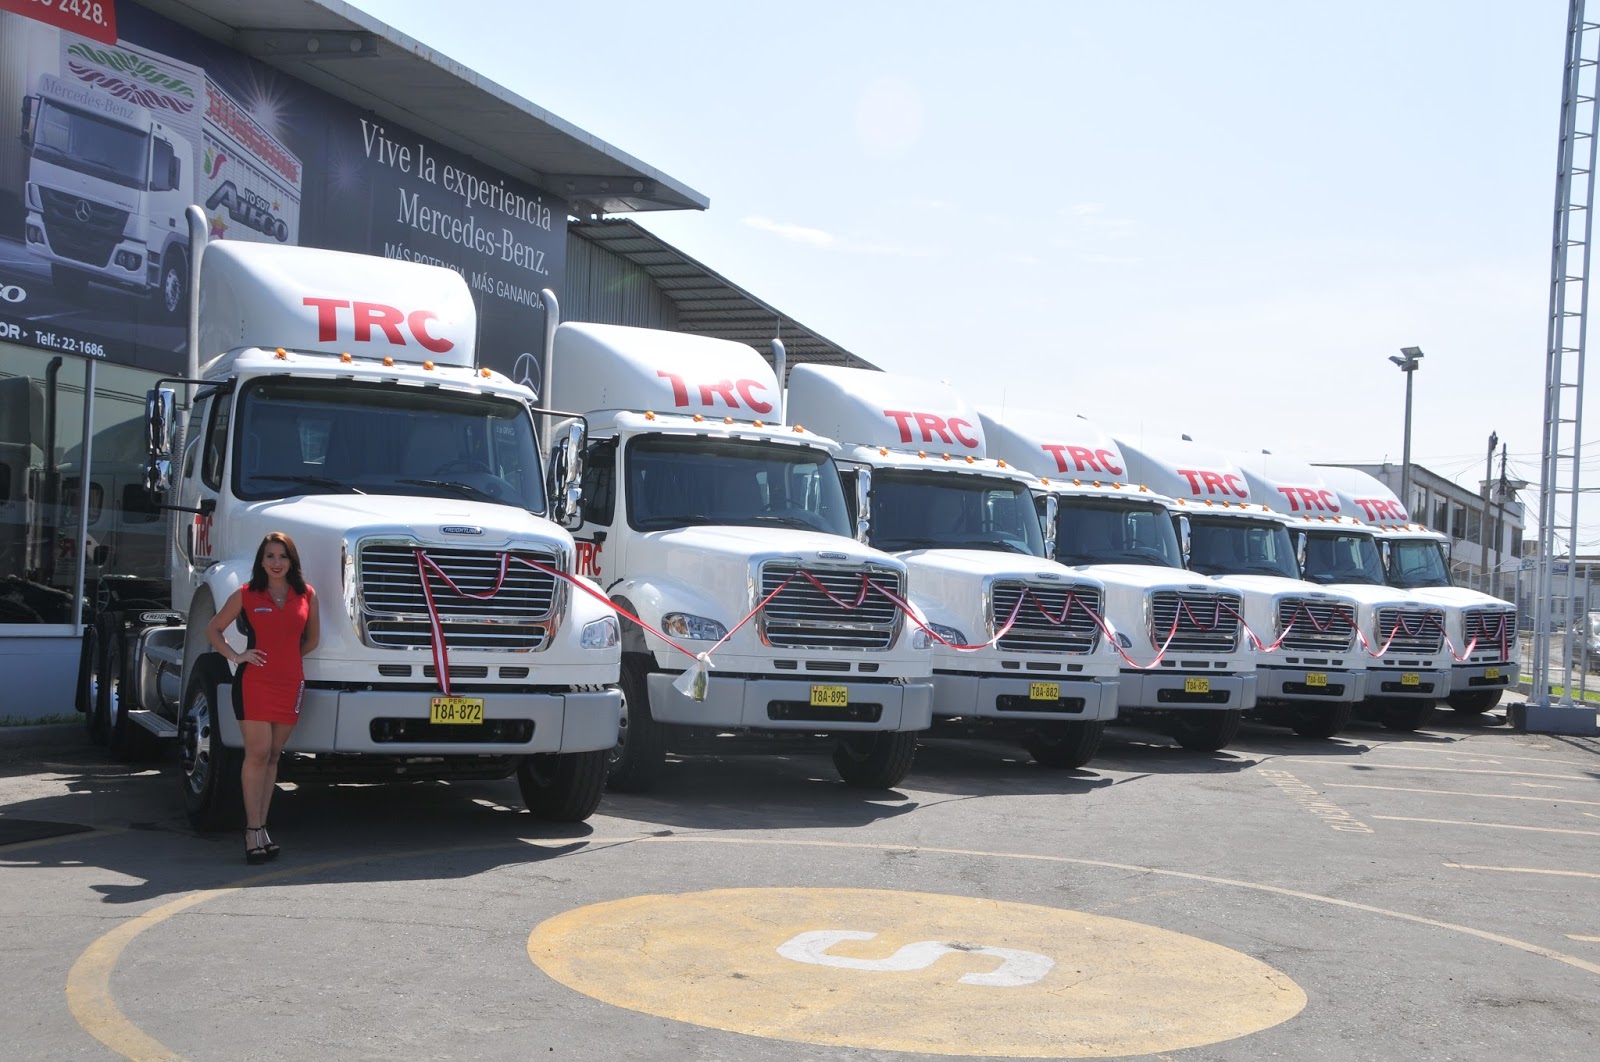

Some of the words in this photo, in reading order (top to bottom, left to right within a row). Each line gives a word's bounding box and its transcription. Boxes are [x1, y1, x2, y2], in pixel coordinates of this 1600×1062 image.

[43, 78, 135, 120] Mercedes-Benz
[359, 118, 411, 173] Vive
[417, 144, 437, 184] la
[443, 165, 552, 232] experiencia
[396, 187, 550, 276] Mercedes-Benz.
[384, 242, 411, 262] MÁS
[471, 271, 495, 295] MÁS
[302, 297, 455, 353] TRC
[62, 336, 107, 358] 22-1686.
[656, 369, 773, 414] TRC
[883, 409, 979, 449] TRC
[1041, 444, 1123, 476] TRC
[1176, 469, 1248, 499] TRC
[1276, 487, 1341, 513] TRC
[1353, 499, 1408, 522] TRC
[195, 514, 213, 557] TRC
[575, 542, 603, 577] TRC
[812, 690, 846, 703] T8A-895
[1031, 686, 1058, 698] T8A-882
[433, 704, 481, 720] T8A-872
[775, 929, 1057, 987] S
